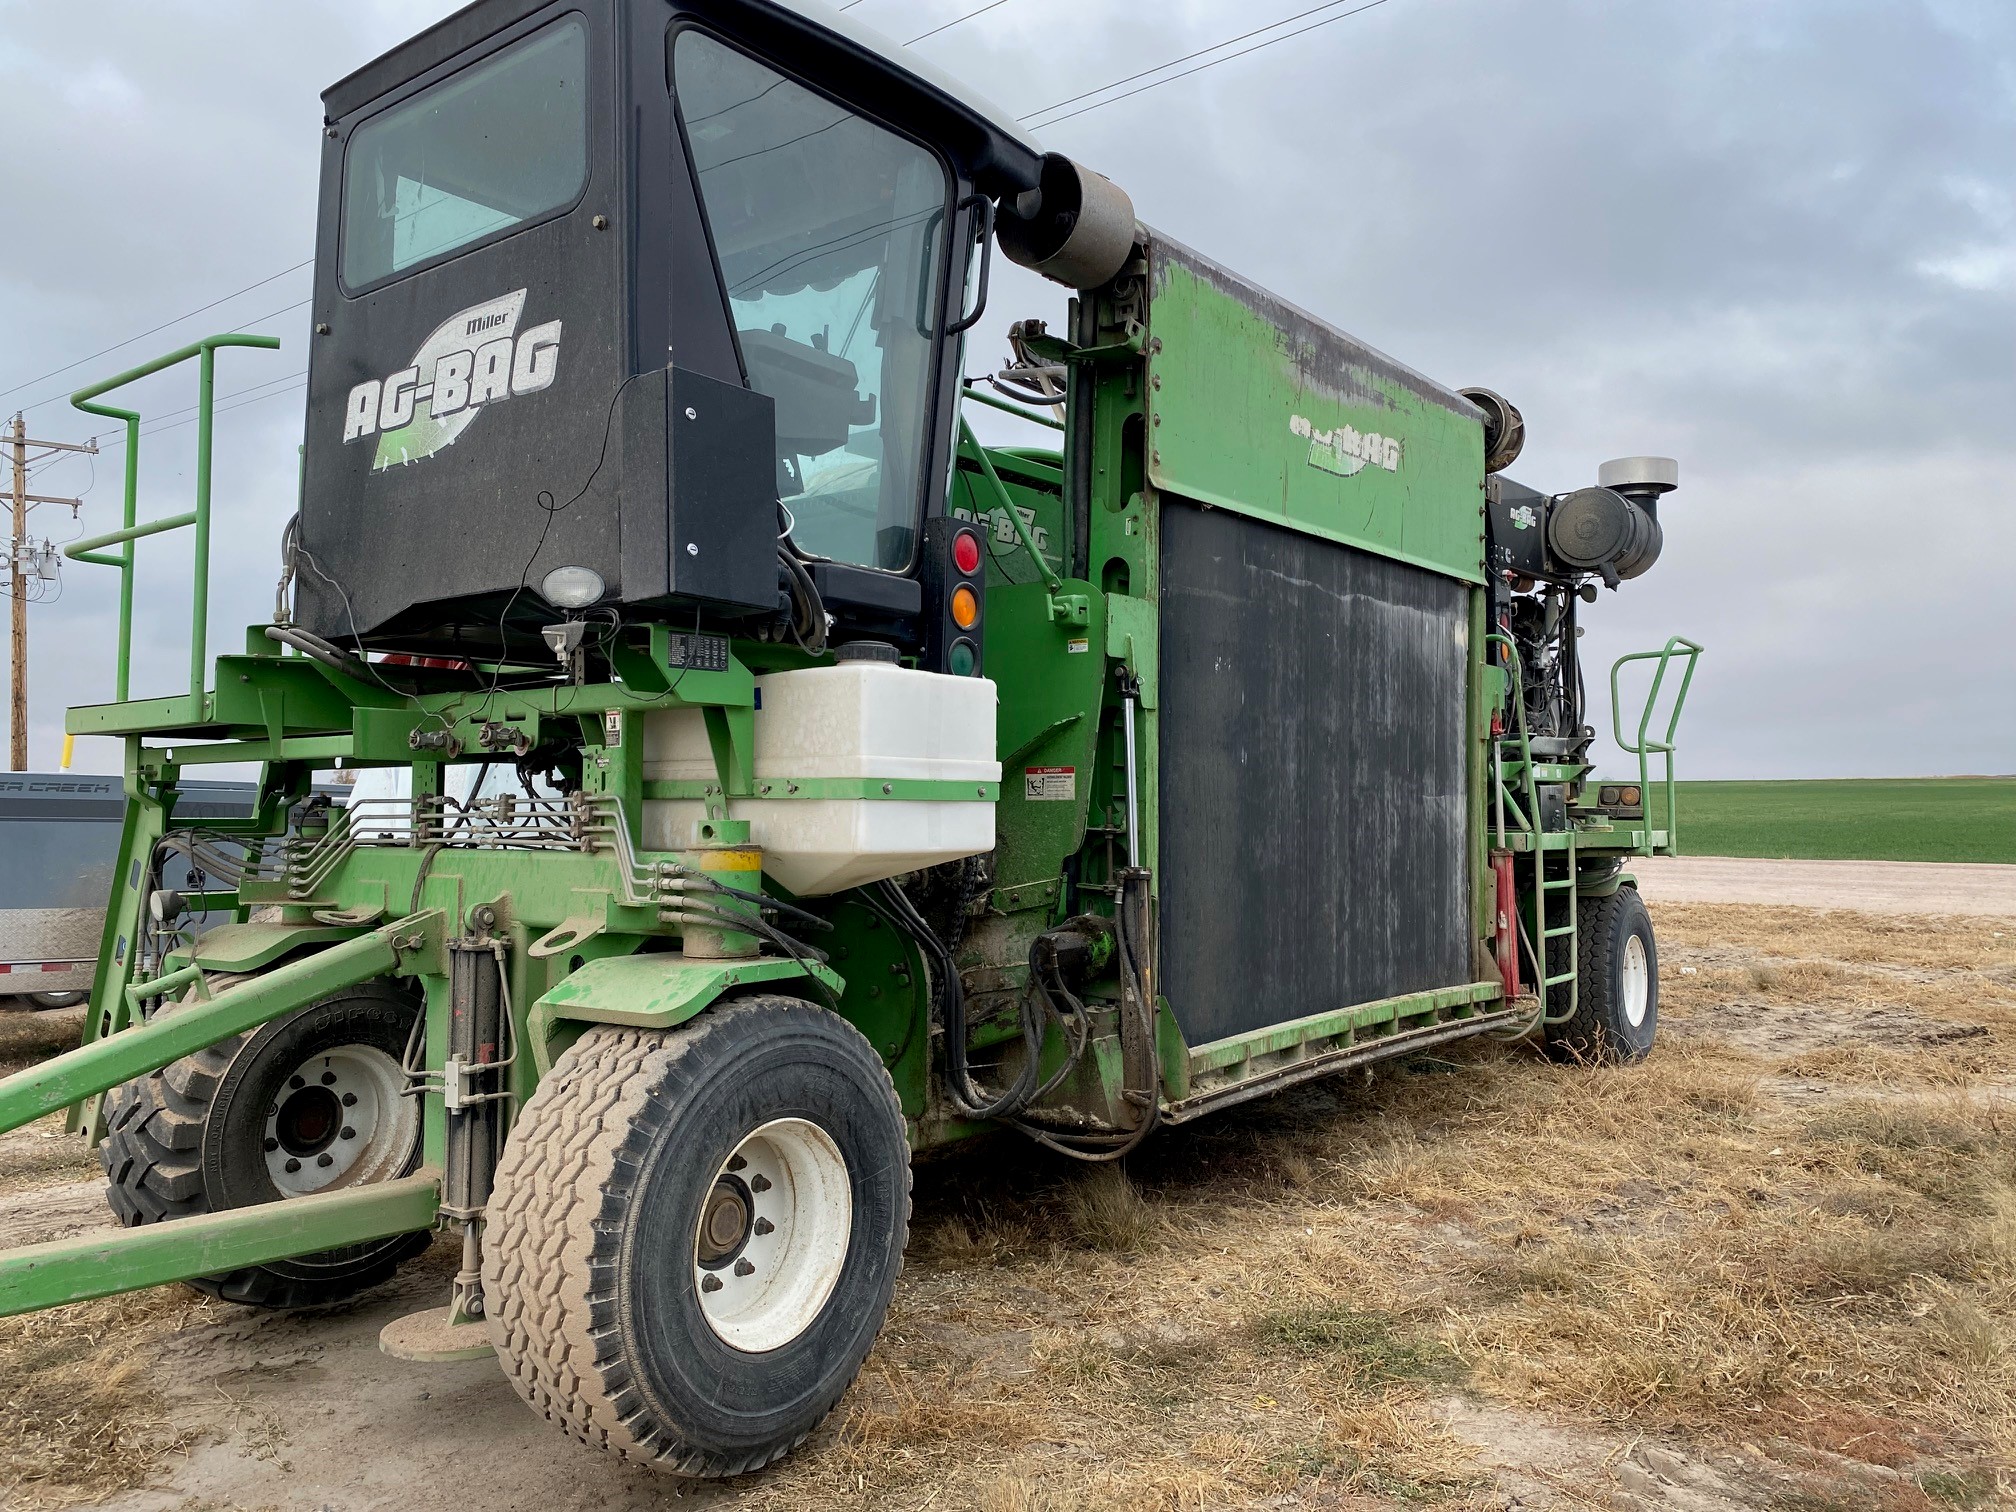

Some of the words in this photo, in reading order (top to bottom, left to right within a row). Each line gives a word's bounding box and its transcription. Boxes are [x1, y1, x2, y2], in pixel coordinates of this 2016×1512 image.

[466, 312, 509, 336] Miller
[343, 318, 563, 445] AG-BAG
[28, 782, 110, 794] CREEK
